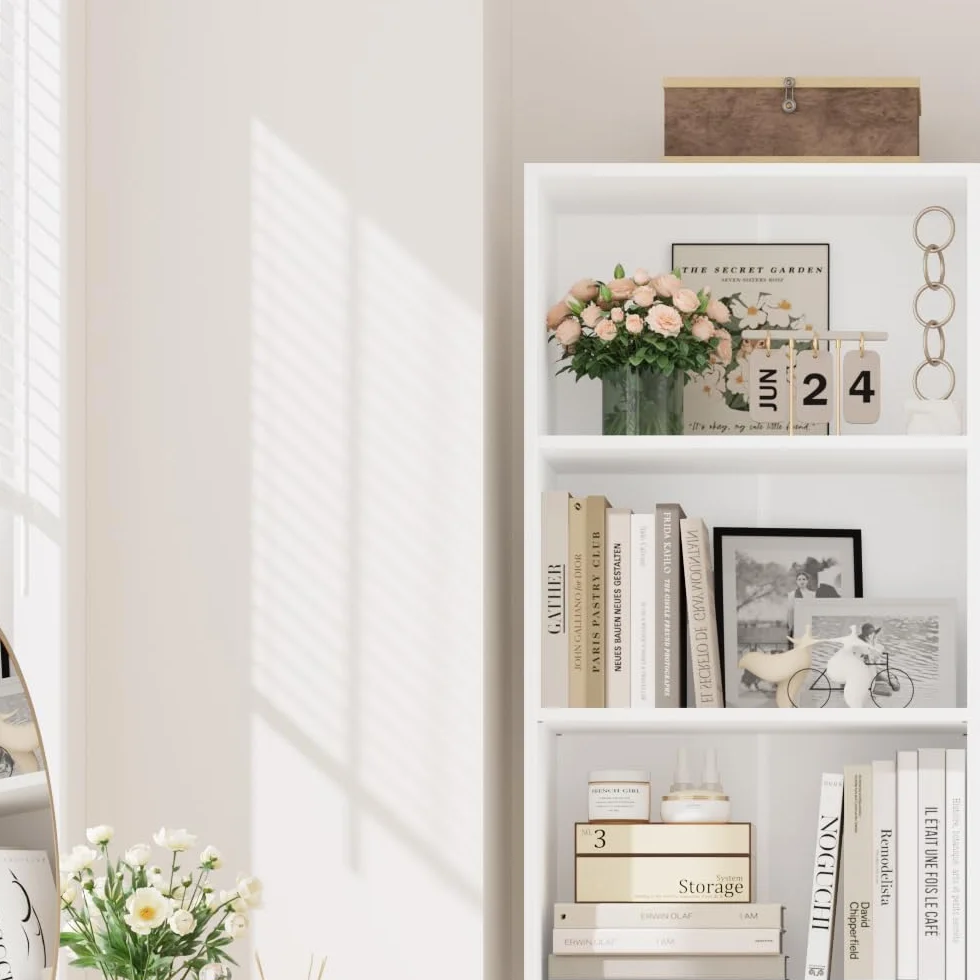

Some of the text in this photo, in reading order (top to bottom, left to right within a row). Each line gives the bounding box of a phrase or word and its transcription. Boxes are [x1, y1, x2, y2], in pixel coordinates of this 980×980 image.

[682, 265, 825, 275] THE SECRET GARDEN
[758, 368, 778, 412] JUN
[802, 370, 875, 406] 2 4
[662, 512, 672, 575] FRIDA KAHLO
[547, 563, 562, 635] GATHER
[573, 553, 583, 672] JOHN GALLIANO for DIOR
[590, 531, 602, 673] PARIS PASTRY CLUB
[613, 543, 623, 672] NEUES BAUEN NEUES GESTALTEN
[924, 807, 940, 816] IL
[594, 829, 607, 849] 3
[880, 828, 893, 907] Remodelista
[924, 849, 940, 869] UNE
[716, 874, 744, 883] System
[811, 815, 840, 932] NOGUCHI
[924, 872, 940, 894] FOIS
[678, 878, 744, 898] Storage
[860, 901, 870, 928] David
[924, 897, 940, 908] LE
[671, 912, 694, 921] OLAF
[743, 912, 759, 921] AM
[563, 939, 592, 947] ERWIN
[847, 901, 860, 960] Chipperfield
